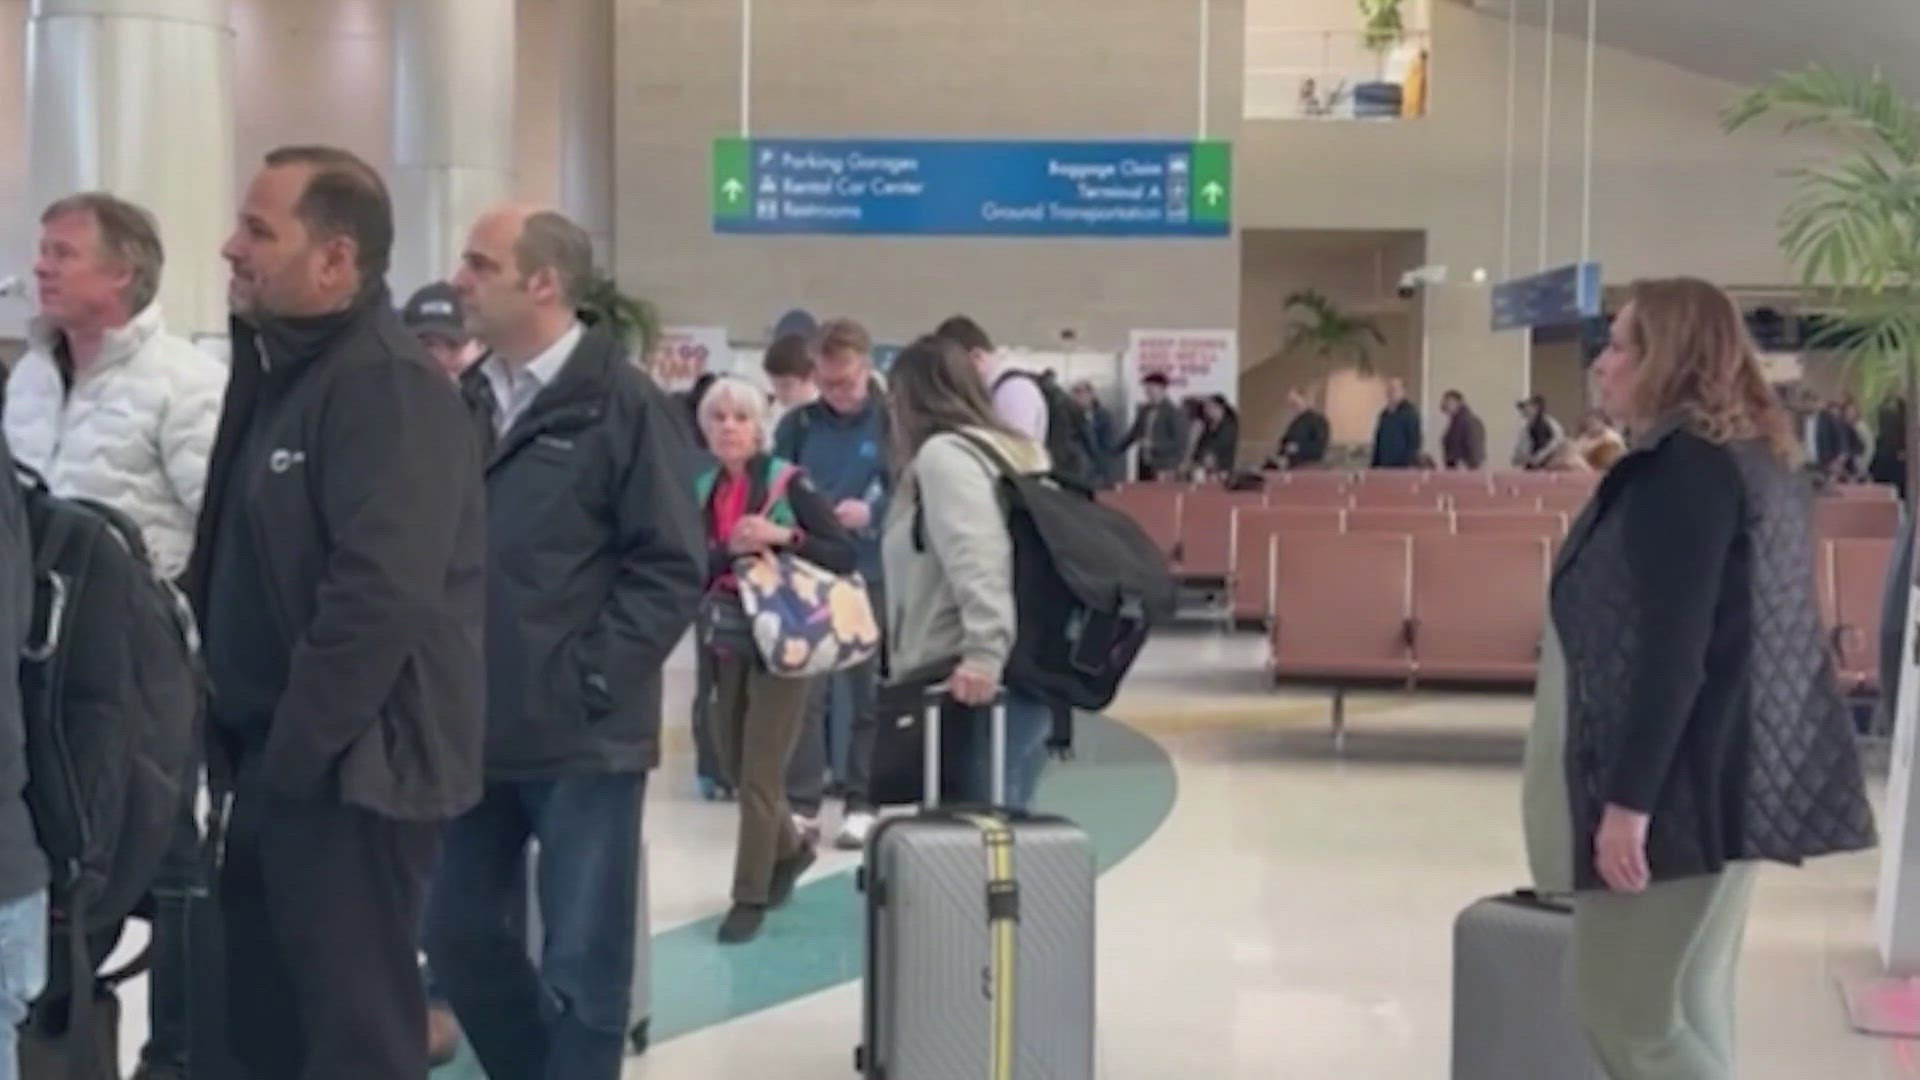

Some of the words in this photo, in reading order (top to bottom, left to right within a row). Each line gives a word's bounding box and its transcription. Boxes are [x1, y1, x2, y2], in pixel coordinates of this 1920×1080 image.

[781, 152, 844, 174] Parking
[847, 152, 918, 174] Garages
[1049, 159, 1115, 179] Baggage
[782, 177, 833, 195] Rental
[836, 176, 866, 196] Car
[870, 176, 923, 196] Center
[1077, 183, 1143, 199] Terminal
[1147, 185, 1161, 199] A
[782, 201, 862, 219] Restrooms
[982, 202, 1044, 221] Ground
[1049, 203, 1162, 225] Transportation
